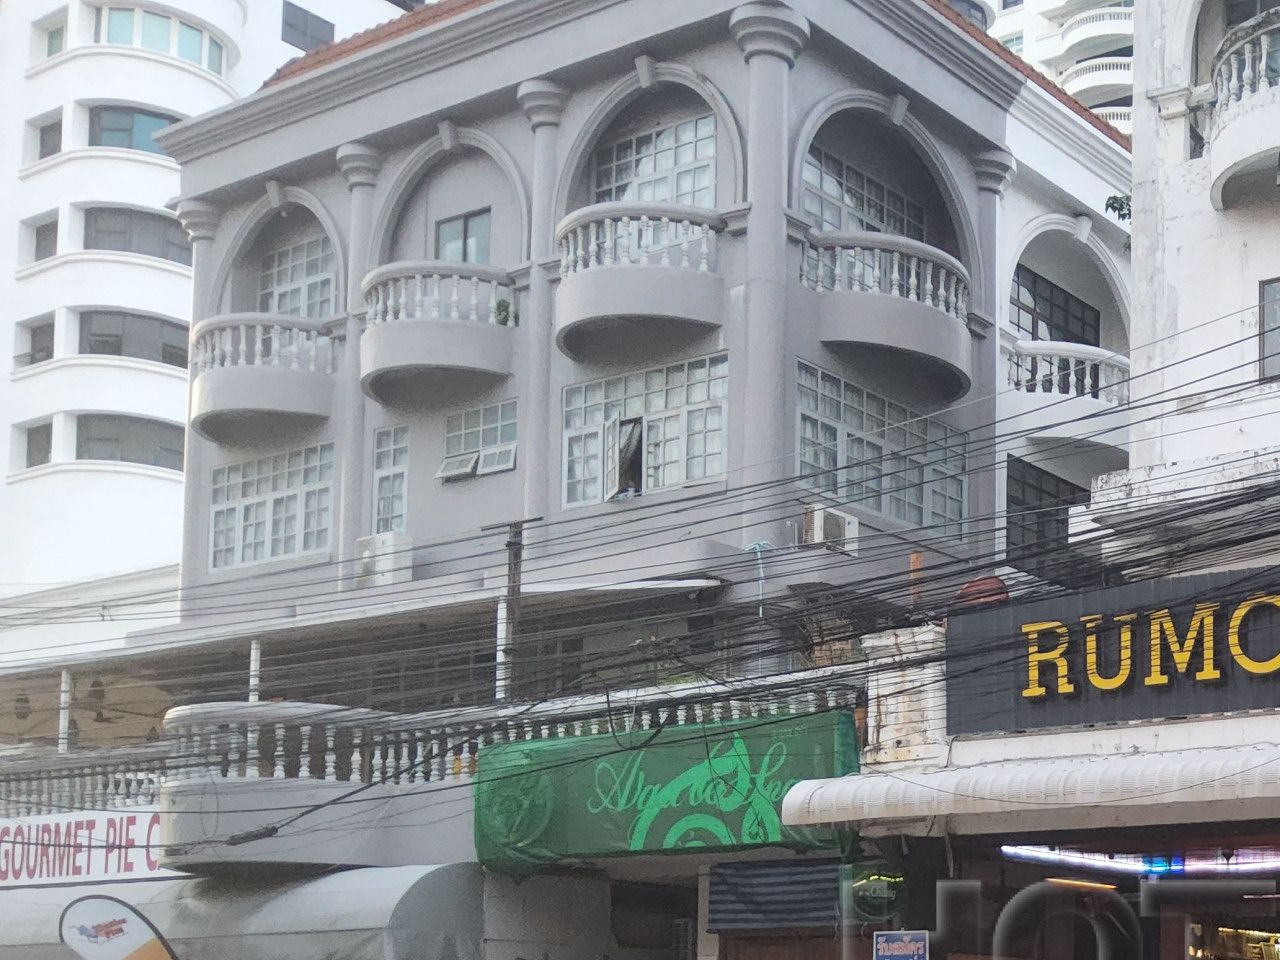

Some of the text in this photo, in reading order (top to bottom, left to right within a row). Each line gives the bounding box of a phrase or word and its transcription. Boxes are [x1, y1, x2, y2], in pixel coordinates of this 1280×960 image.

[0, 811, 161, 881] GOURMET PIE C
